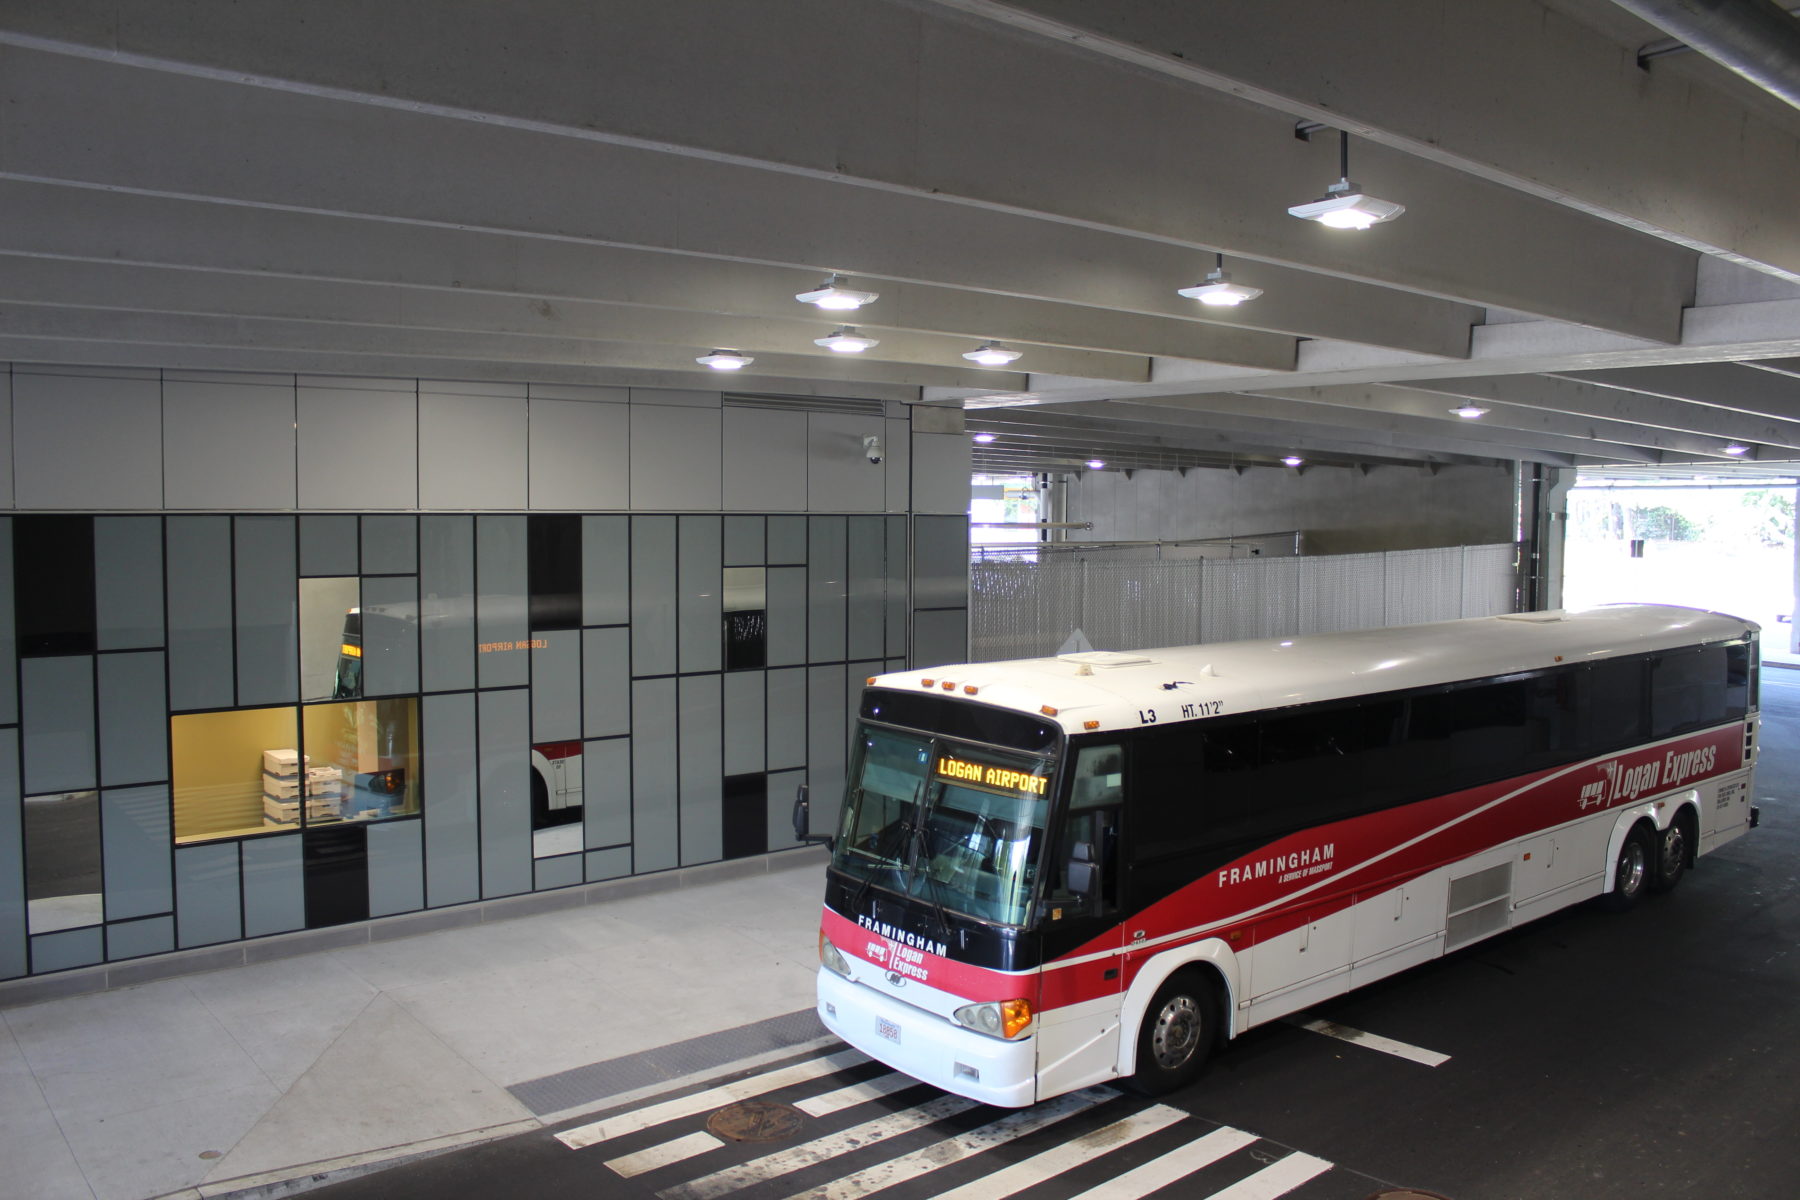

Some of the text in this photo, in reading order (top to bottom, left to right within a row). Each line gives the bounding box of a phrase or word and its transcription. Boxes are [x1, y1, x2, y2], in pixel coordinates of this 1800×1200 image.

[1139, 709, 1157, 724] L3
[1181, 703, 1198, 718] HT.
[939, 758, 1048, 795] LOGAN AIRPORT
[1613, 744, 1717, 800] Logan Express
[1218, 843, 1335, 888] FRAMINGHAM
[858, 914, 947, 958] FRAMINGHAM
[893, 956, 928, 981] Express
[896, 943, 924, 964] Logan
